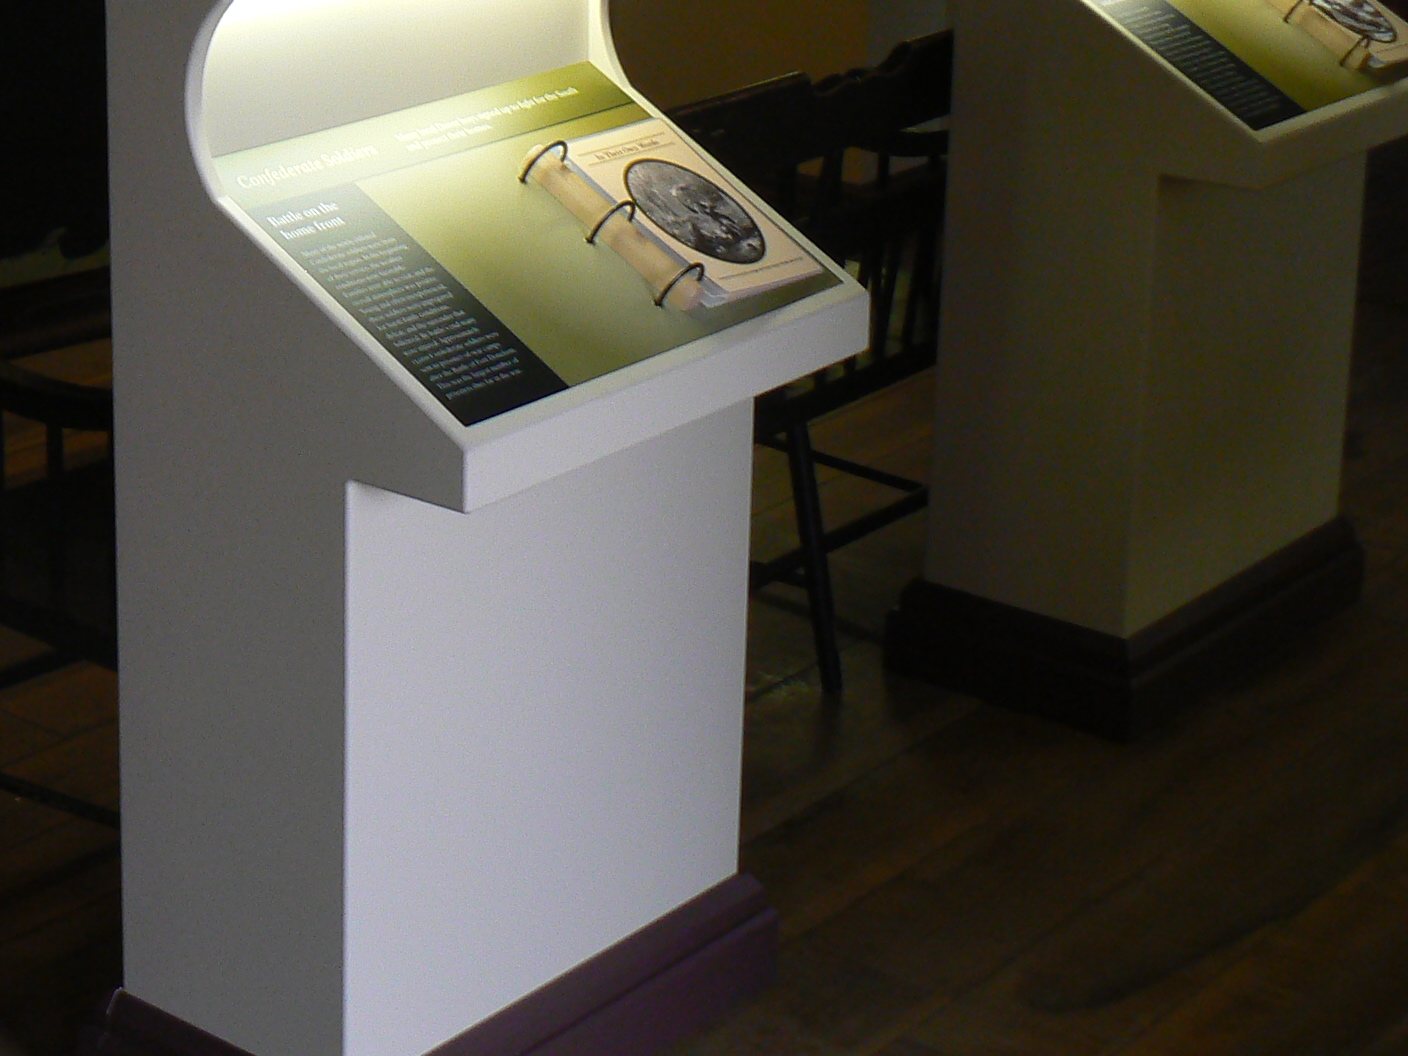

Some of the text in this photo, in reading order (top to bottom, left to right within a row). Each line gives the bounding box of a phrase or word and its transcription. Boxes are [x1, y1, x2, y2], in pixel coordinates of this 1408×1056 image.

[237, 145, 378, 188] Confederate Soldiers
[267, 201, 339, 228] Battle on the
[280, 216, 345, 240] home front
